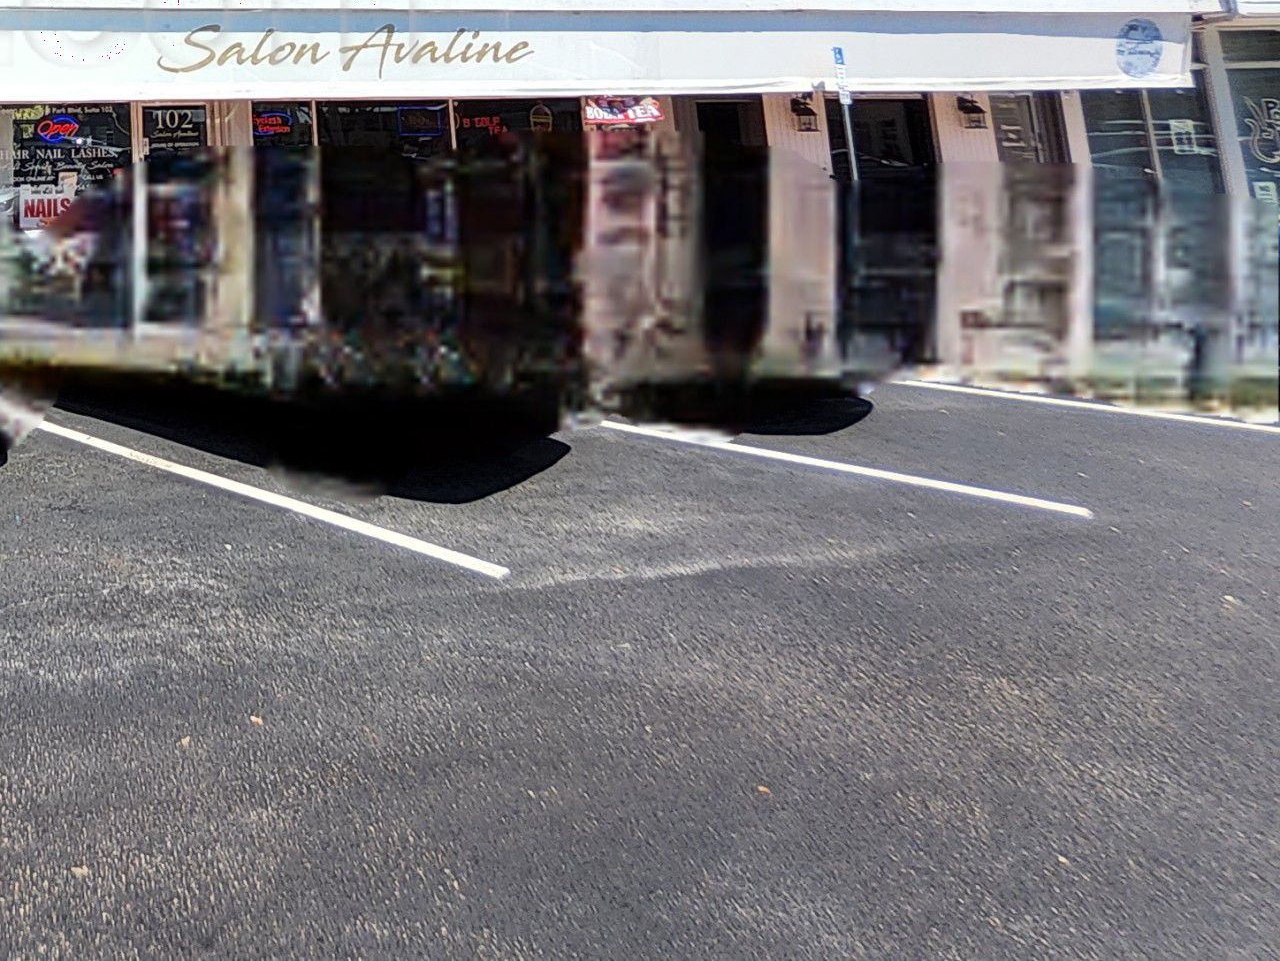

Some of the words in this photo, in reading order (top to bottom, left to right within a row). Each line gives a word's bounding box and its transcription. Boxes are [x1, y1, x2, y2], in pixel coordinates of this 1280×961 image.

[157, 24, 330, 73] Salon
[340, 23, 534, 79] Avaline
[155, 110, 194, 128] 102
[627, 104, 662, 119] TEA
[38, 120, 79, 139] Open
[36, 149, 65, 158] NAIL
[24, 198, 71, 218] NAILS
